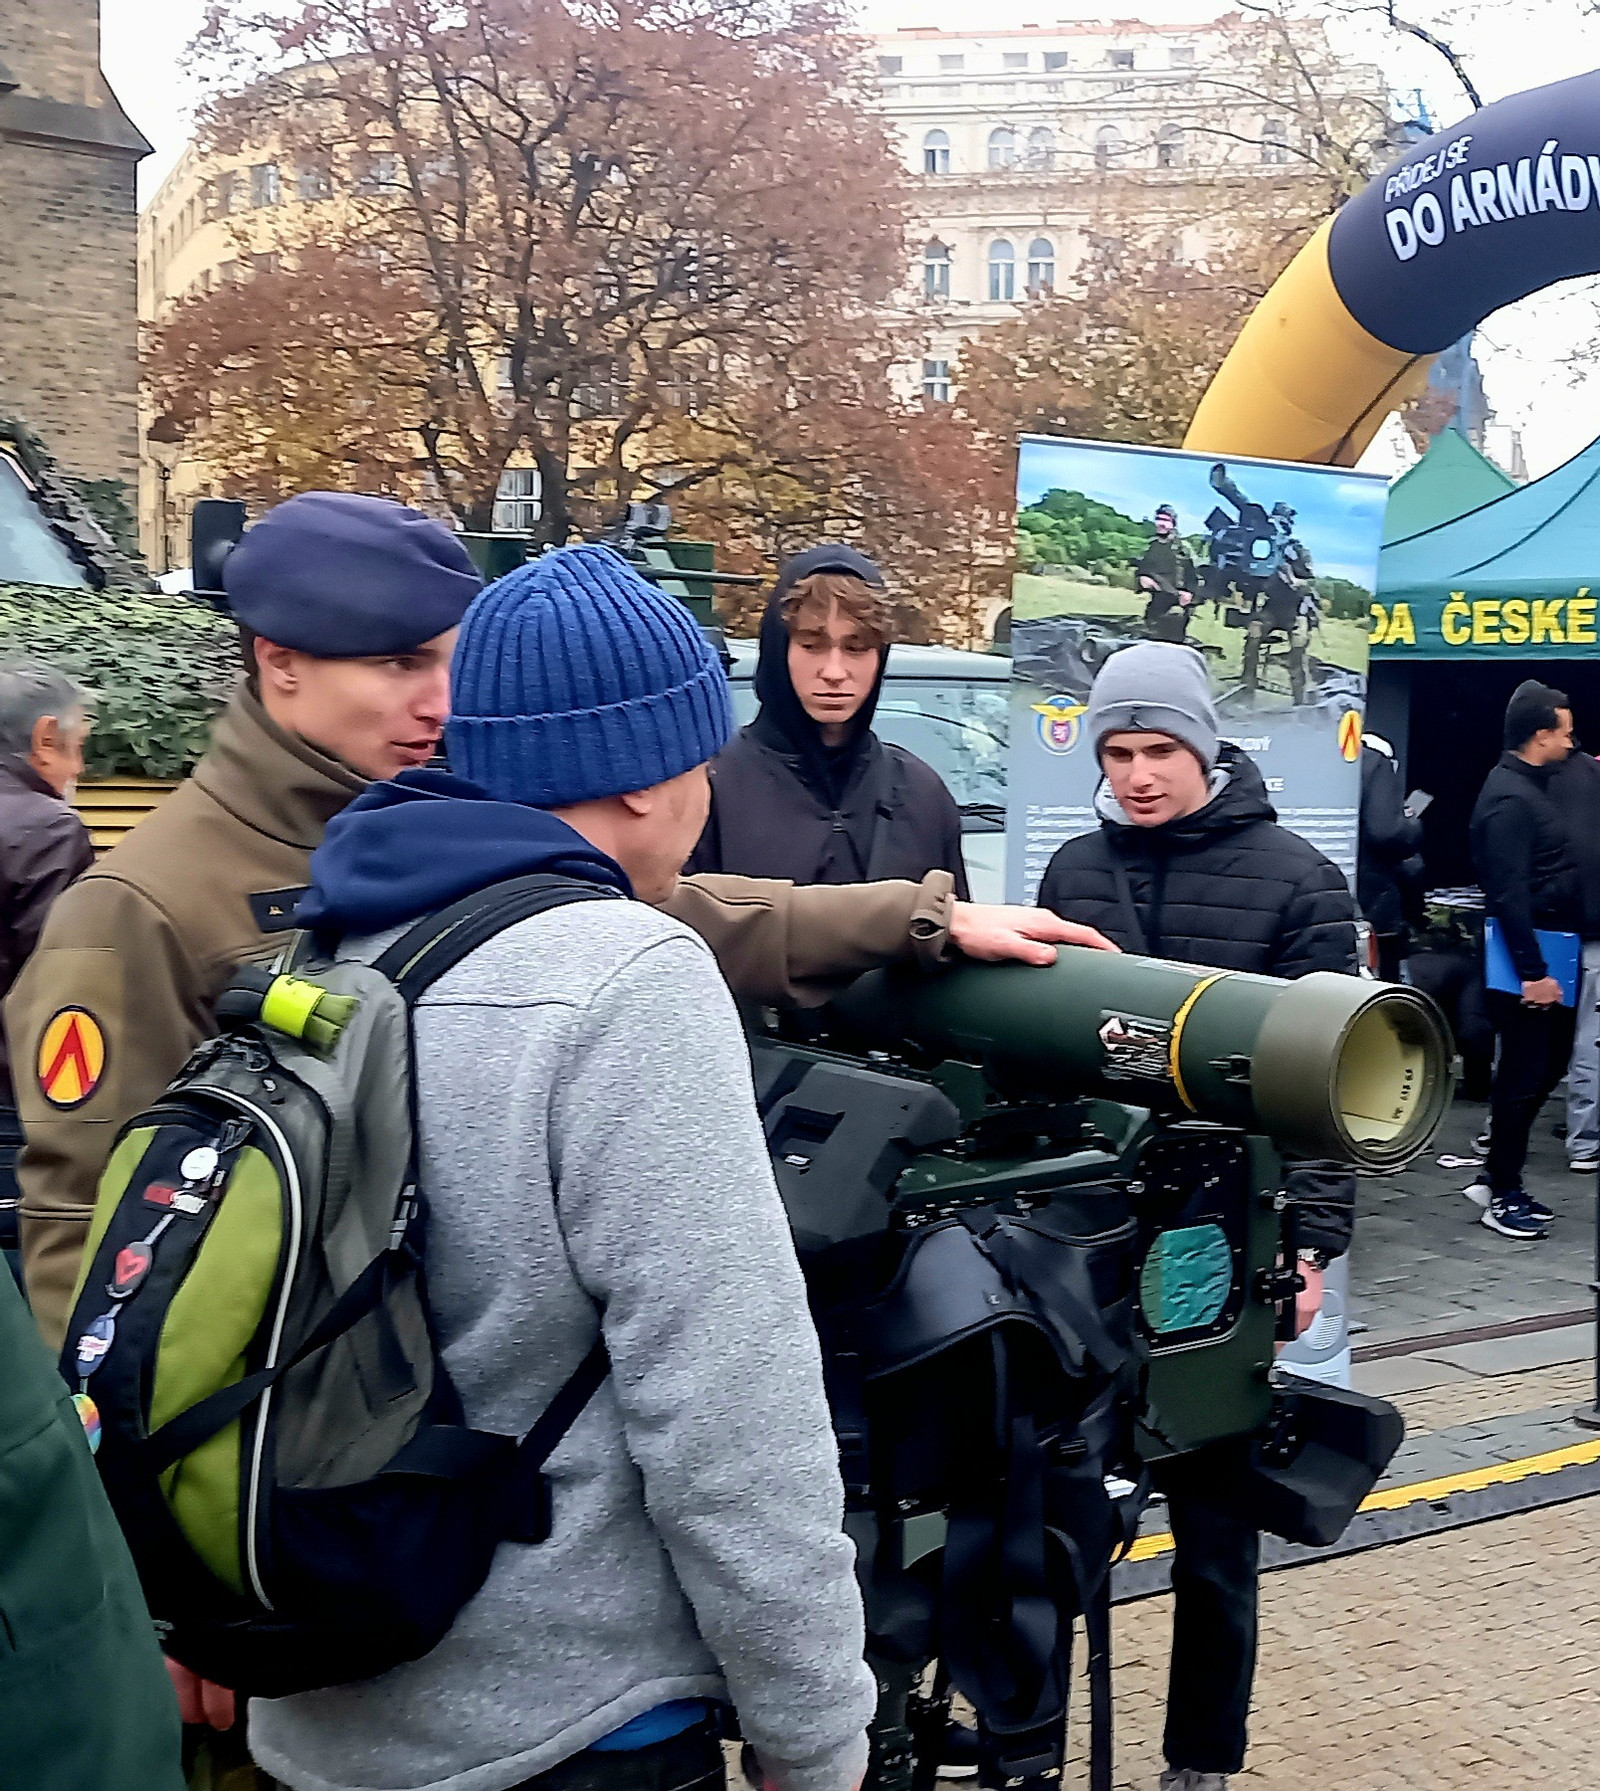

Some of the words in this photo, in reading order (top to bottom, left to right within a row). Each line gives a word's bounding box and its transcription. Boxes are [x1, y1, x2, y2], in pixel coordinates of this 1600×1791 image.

[1445, 135, 1474, 169] SE
[1384, 192, 1445, 261] DO
[1441, 588, 1597, 646] ČESKÉ
